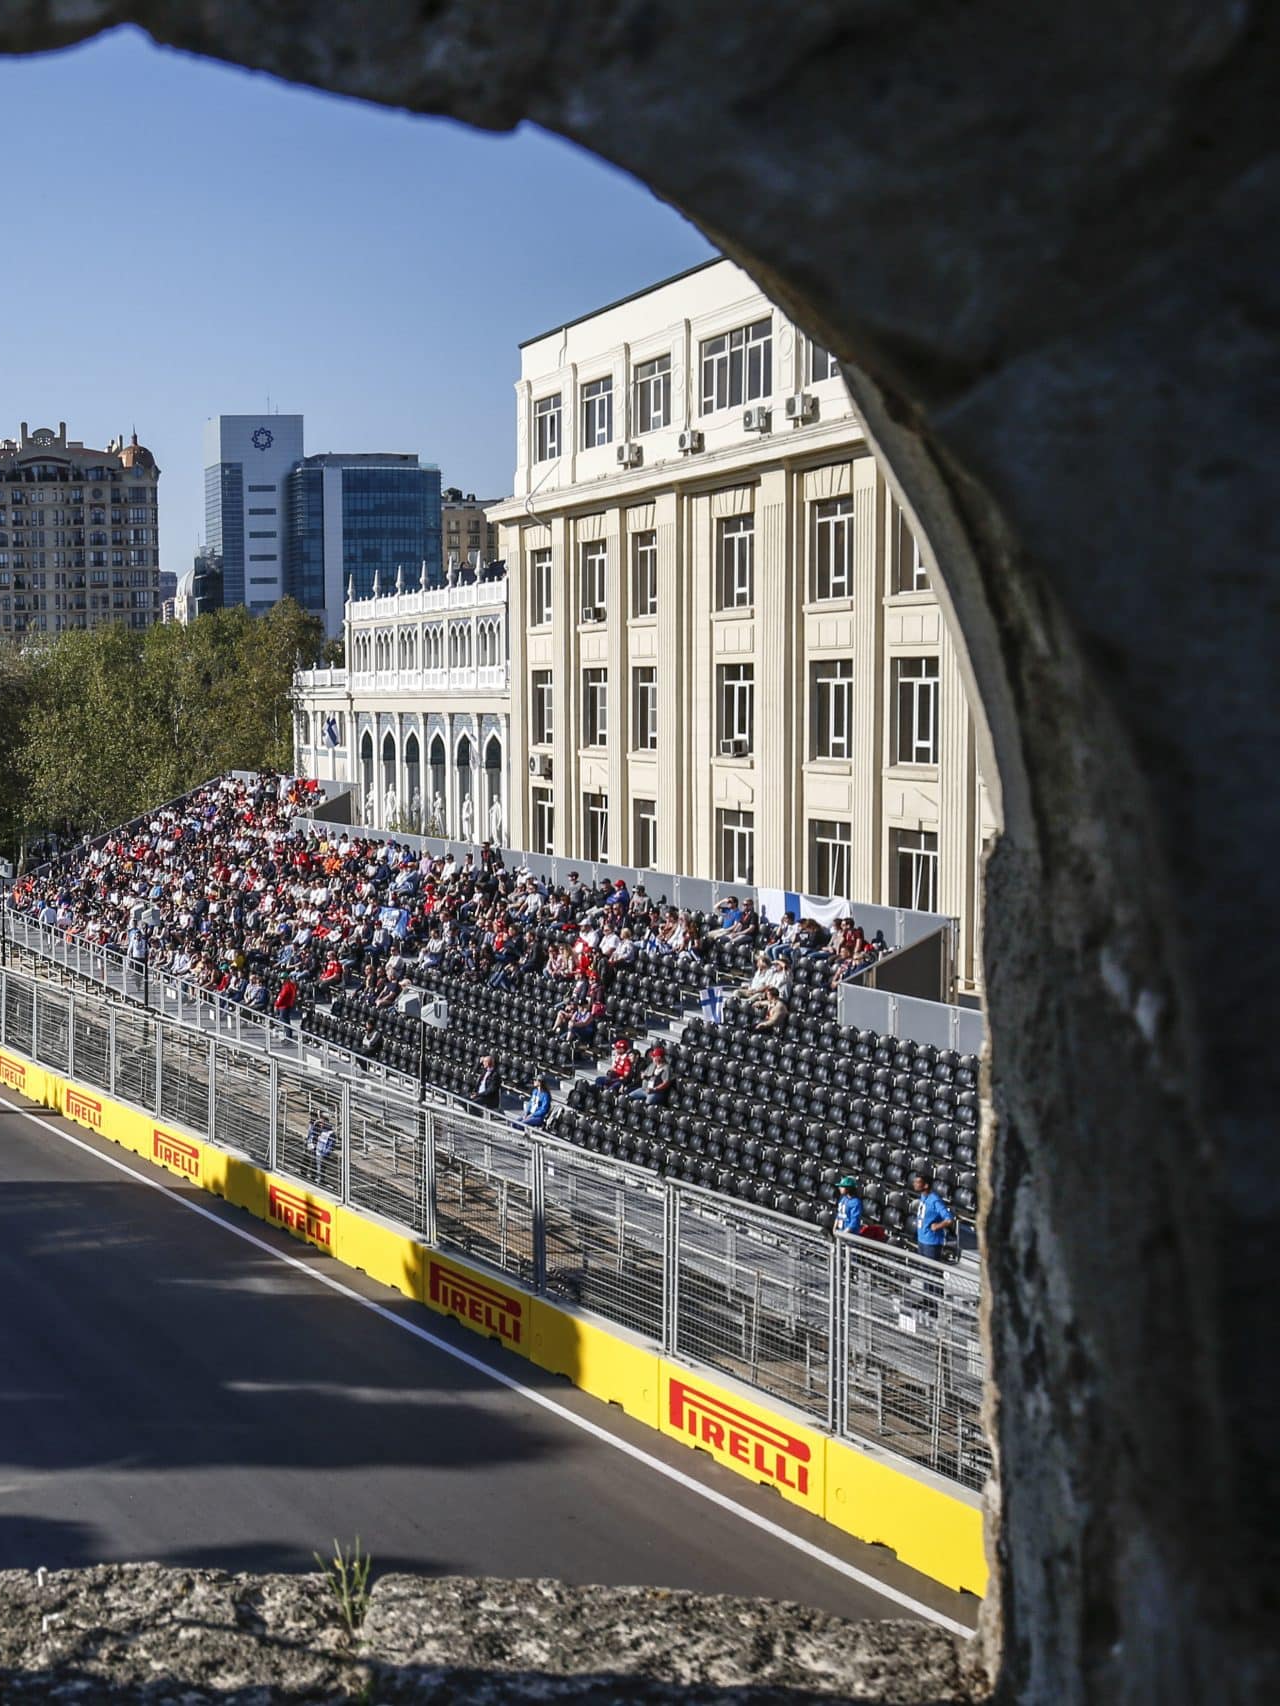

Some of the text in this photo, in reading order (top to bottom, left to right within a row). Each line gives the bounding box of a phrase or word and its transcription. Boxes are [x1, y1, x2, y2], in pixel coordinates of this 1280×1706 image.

[0, 1055, 26, 1089] PIRELLI
[66, 1088, 101, 1128] PIRELLI
[154, 1129, 199, 1177] PIRELLI
[270, 1184, 331, 1246] PIRELLI
[430, 1261, 522, 1344] PIRELLI
[669, 1378, 811, 1496] PIRELLI
